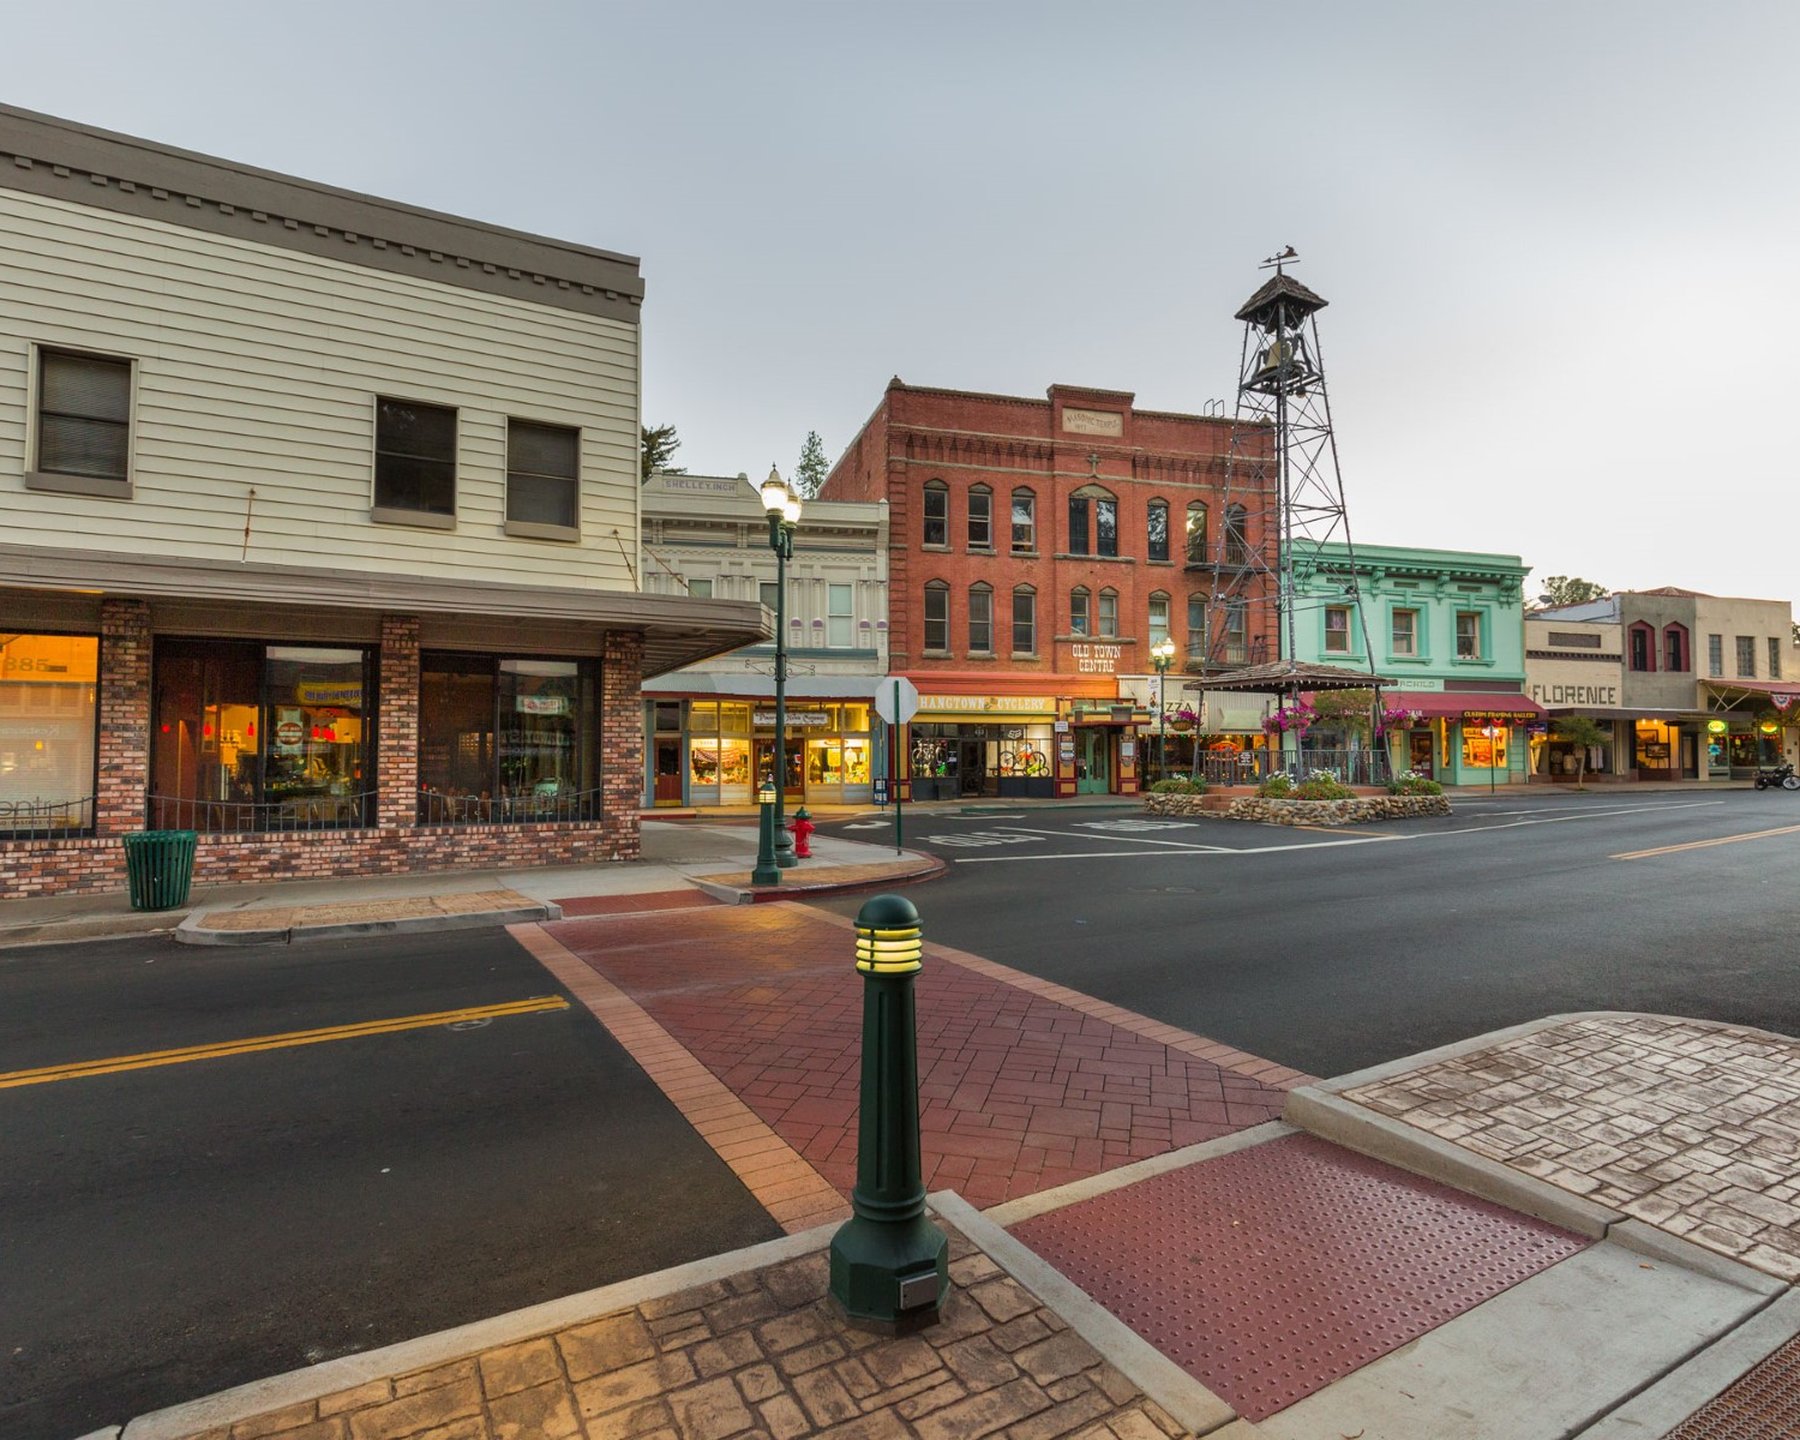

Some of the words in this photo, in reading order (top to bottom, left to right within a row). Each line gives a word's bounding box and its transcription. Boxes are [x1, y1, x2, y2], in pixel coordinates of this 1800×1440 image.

[1072, 644, 1089, 658] OLD
[1093, 645, 1121, 659] TOWN
[1079, 658, 1115, 673] CENTRE
[1532, 684, 1616, 705] FLORENCE
[920, 695, 985, 710] HANGTOWN
[997, 697, 1045, 711] CYCLERY
